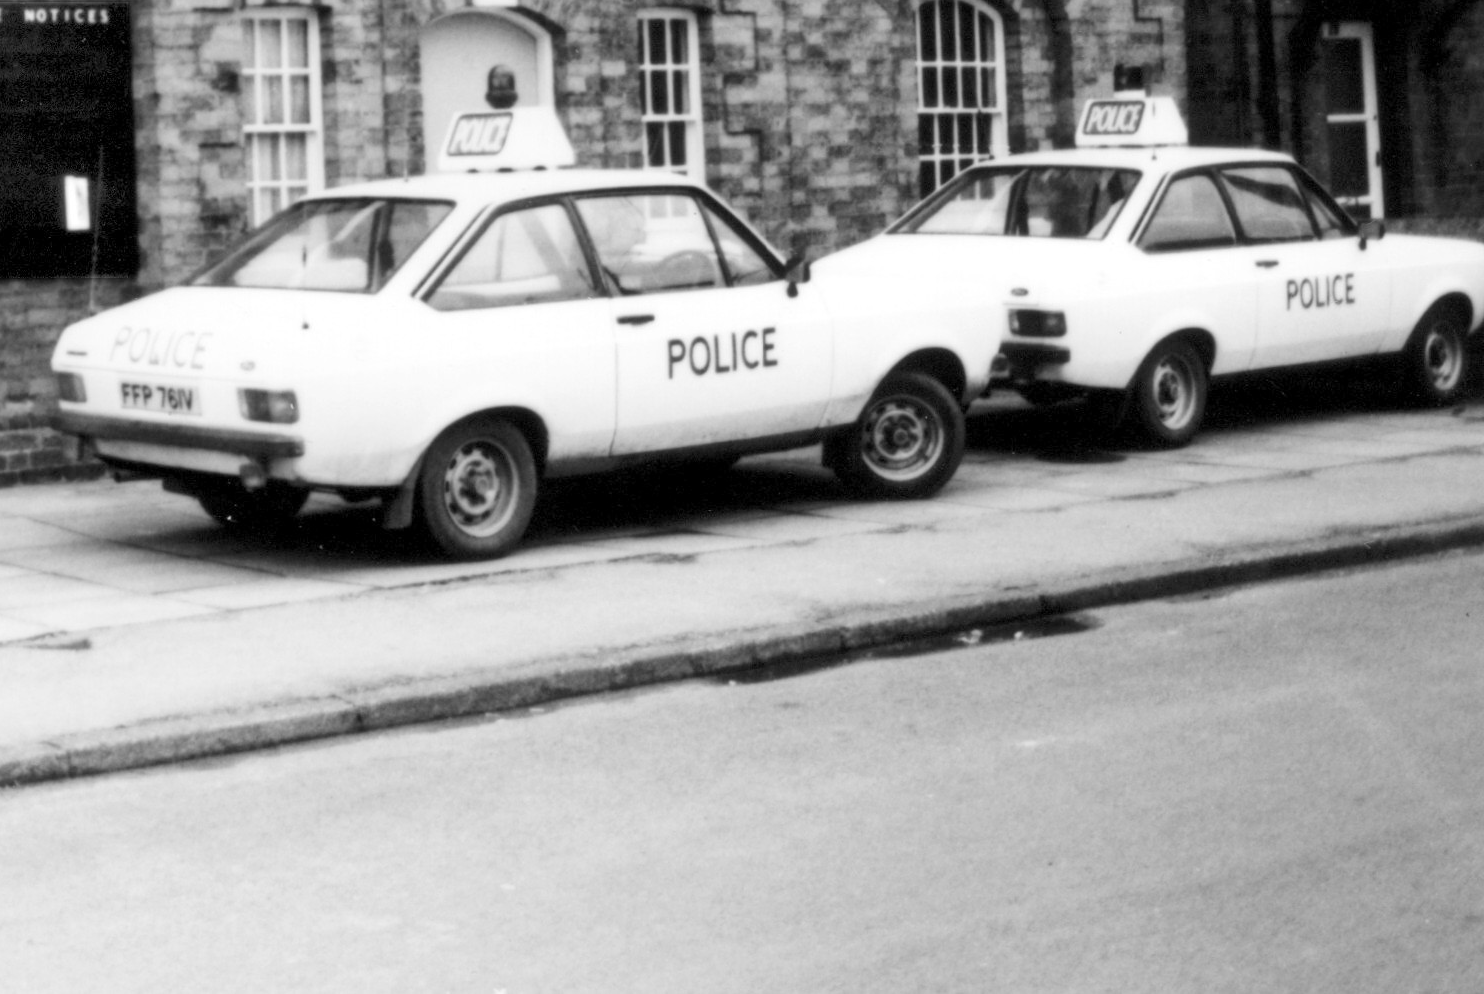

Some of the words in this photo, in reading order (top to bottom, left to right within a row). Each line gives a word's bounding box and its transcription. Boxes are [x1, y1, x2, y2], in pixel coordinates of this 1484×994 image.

[24, 8, 109, 24] NOTICES
[1085, 104, 1143, 133] POLICE
[1286, 273, 1355, 311] POLICE
[109, 325, 214, 370] POLICE
[668, 327, 778, 379] POLICE
[120, 383, 153, 406] FFP
